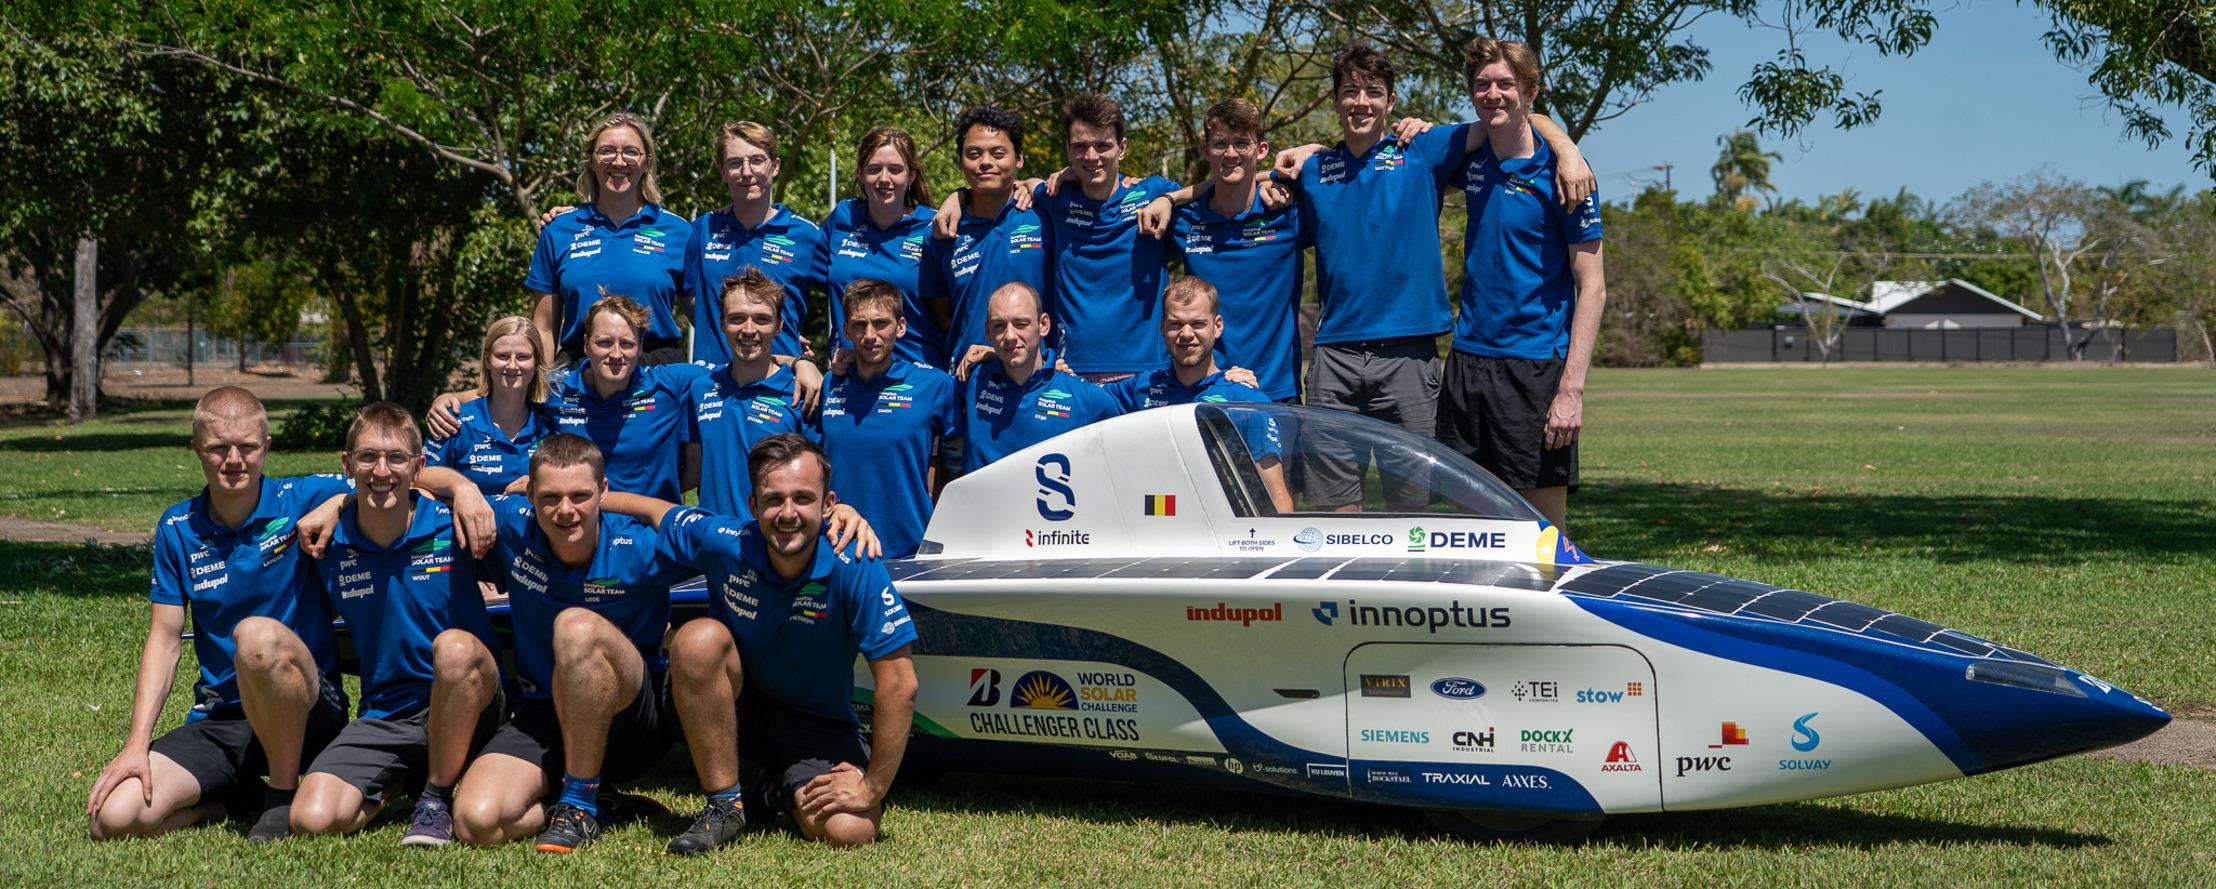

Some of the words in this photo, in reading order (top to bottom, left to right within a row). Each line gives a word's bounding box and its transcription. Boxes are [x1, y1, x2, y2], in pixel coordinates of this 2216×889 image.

[474, 443, 491, 452] pwc
[476, 454, 502, 462] DEME
[1038, 530, 1090, 545] infinite
[1326, 533, 1395, 546] SIBELCO
[1430, 531, 1507, 549] DEME
[190, 550, 210, 563] pwc
[411, 558, 434, 566] SOLAR
[434, 556, 454, 564] TEAM
[195, 560, 226, 577] DEME
[339, 558, 358, 571] pwc
[520, 560, 550, 583] DEME
[343, 571, 372, 584] DEME
[411, 574, 431, 582] WOUT
[728, 574, 751, 588] pwc
[583, 587, 606, 595] SOLAR
[728, 588, 760, 607] DEME
[1186, 602, 1283, 627] indupol
[1348, 599, 1512, 634] innoptus
[1077, 672, 1136, 687] WORLD
[1080, 687, 1137, 702] SOLAR
[1442, 681, 1476, 697] Ford
[1576, 687, 1625, 704] stow
[1081, 702, 1138, 714] CHALLENGE
[970, 712, 1081, 738] CHALLENGER
[1083, 716, 1140, 742] CLASS
[1360, 729, 1430, 744] SIEMENS
[1520, 729, 1574, 744] DOCKX
[1520, 743, 1574, 754] RENTAL
[1601, 764, 1643, 772] AXALTA
[1675, 756, 1732, 778] pwc
[1778, 759, 1832, 771] SOLVAY
[1421, 772, 1491, 786] TRAXIAL
